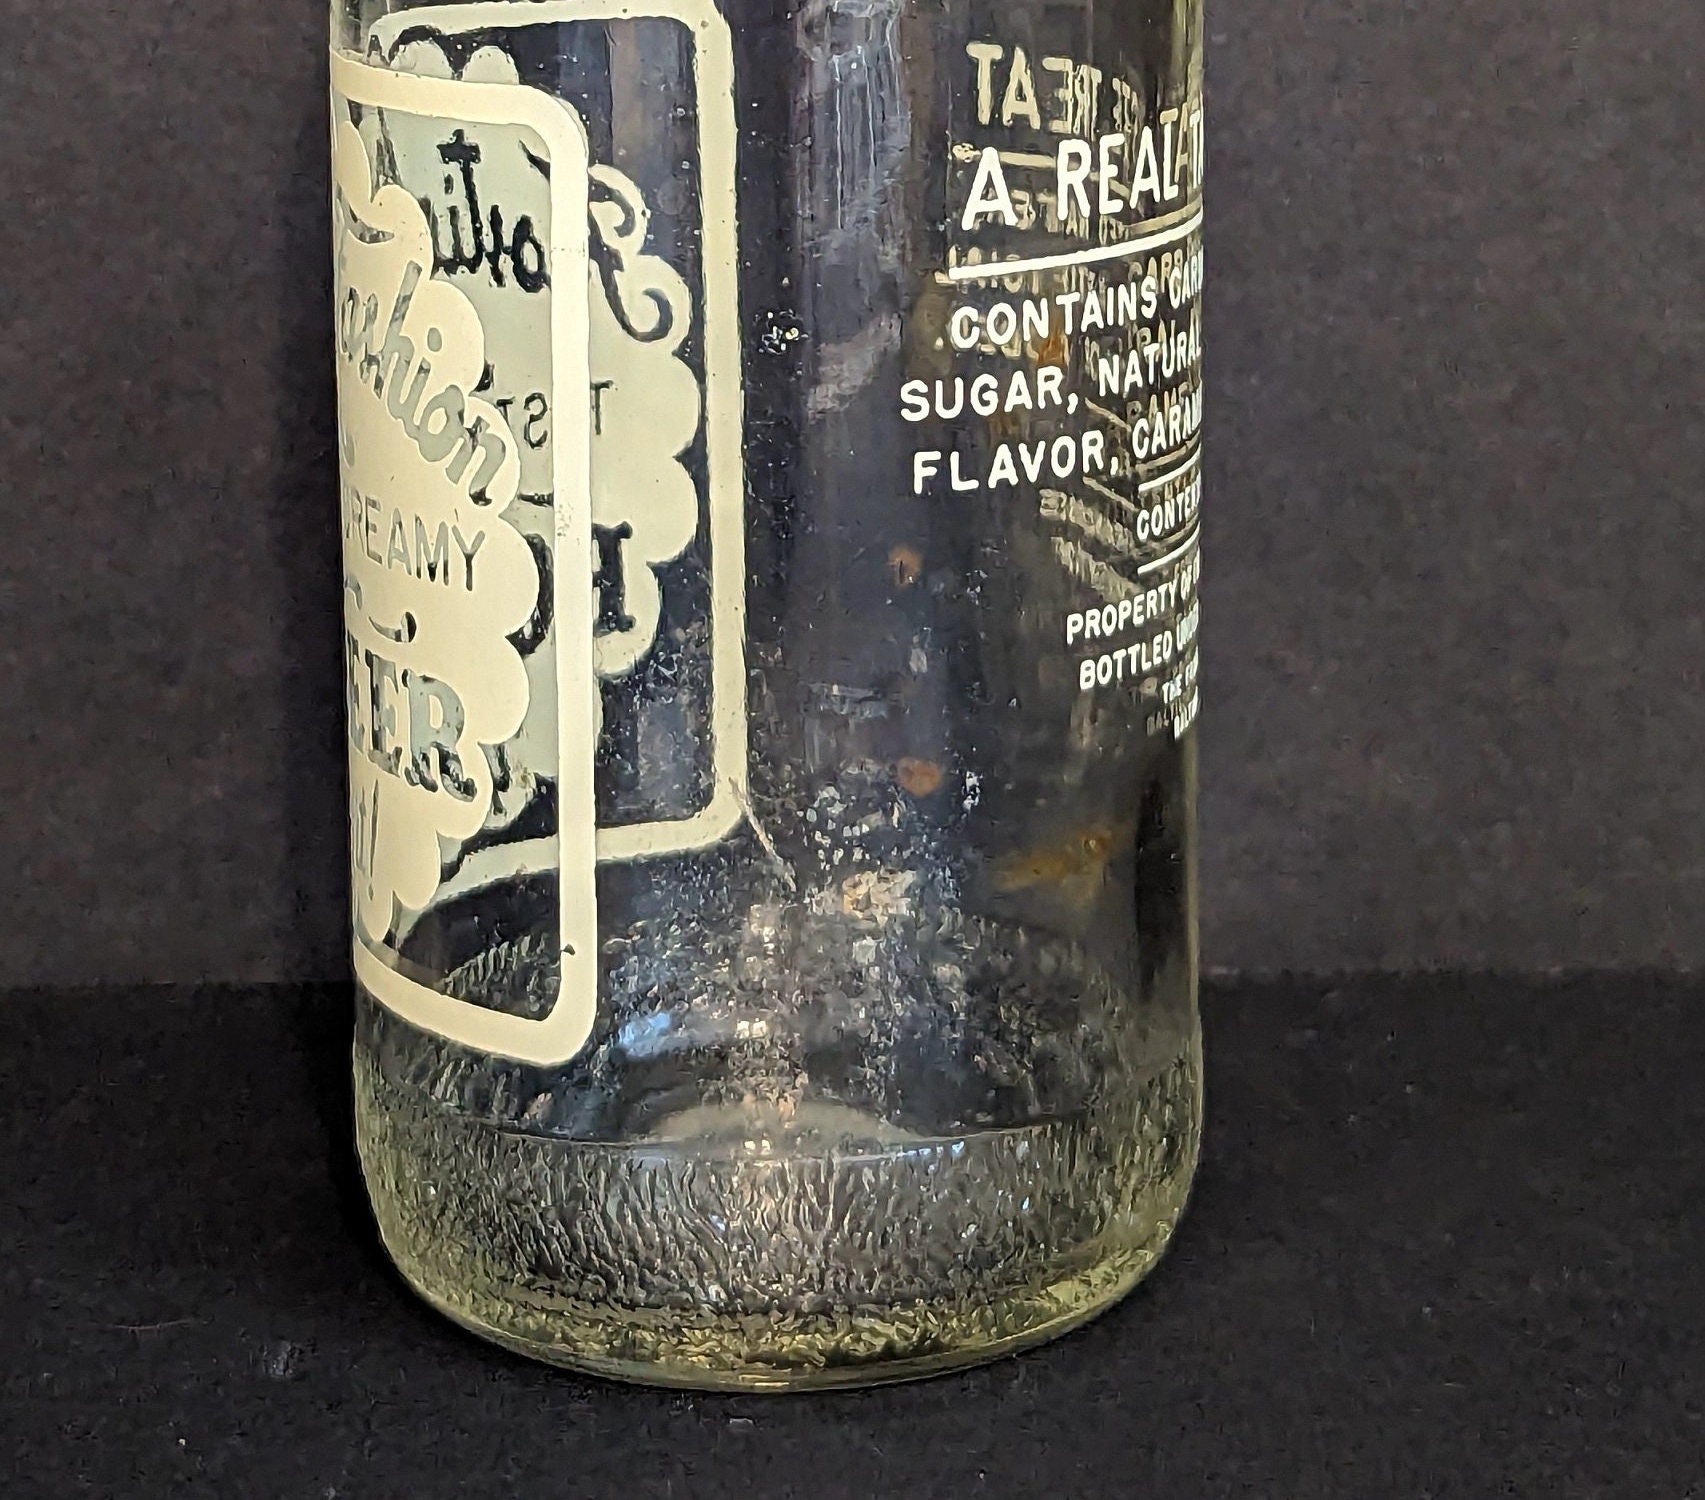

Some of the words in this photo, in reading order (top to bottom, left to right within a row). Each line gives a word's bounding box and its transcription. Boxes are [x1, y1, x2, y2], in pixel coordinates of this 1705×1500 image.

[961, 146, 1018, 231] A
[1056, 122, 1179, 221] REAL
[951, 275, 1157, 350] CONTAINS
[900, 366, 1078, 422] SUGAR,
[912, 430, 1119, 495] FLAVOR,
[1066, 577, 1178, 645] PROPERTY
[1080, 629, 1173, 691] BOTTLED
[347, 629, 479, 801] EER
